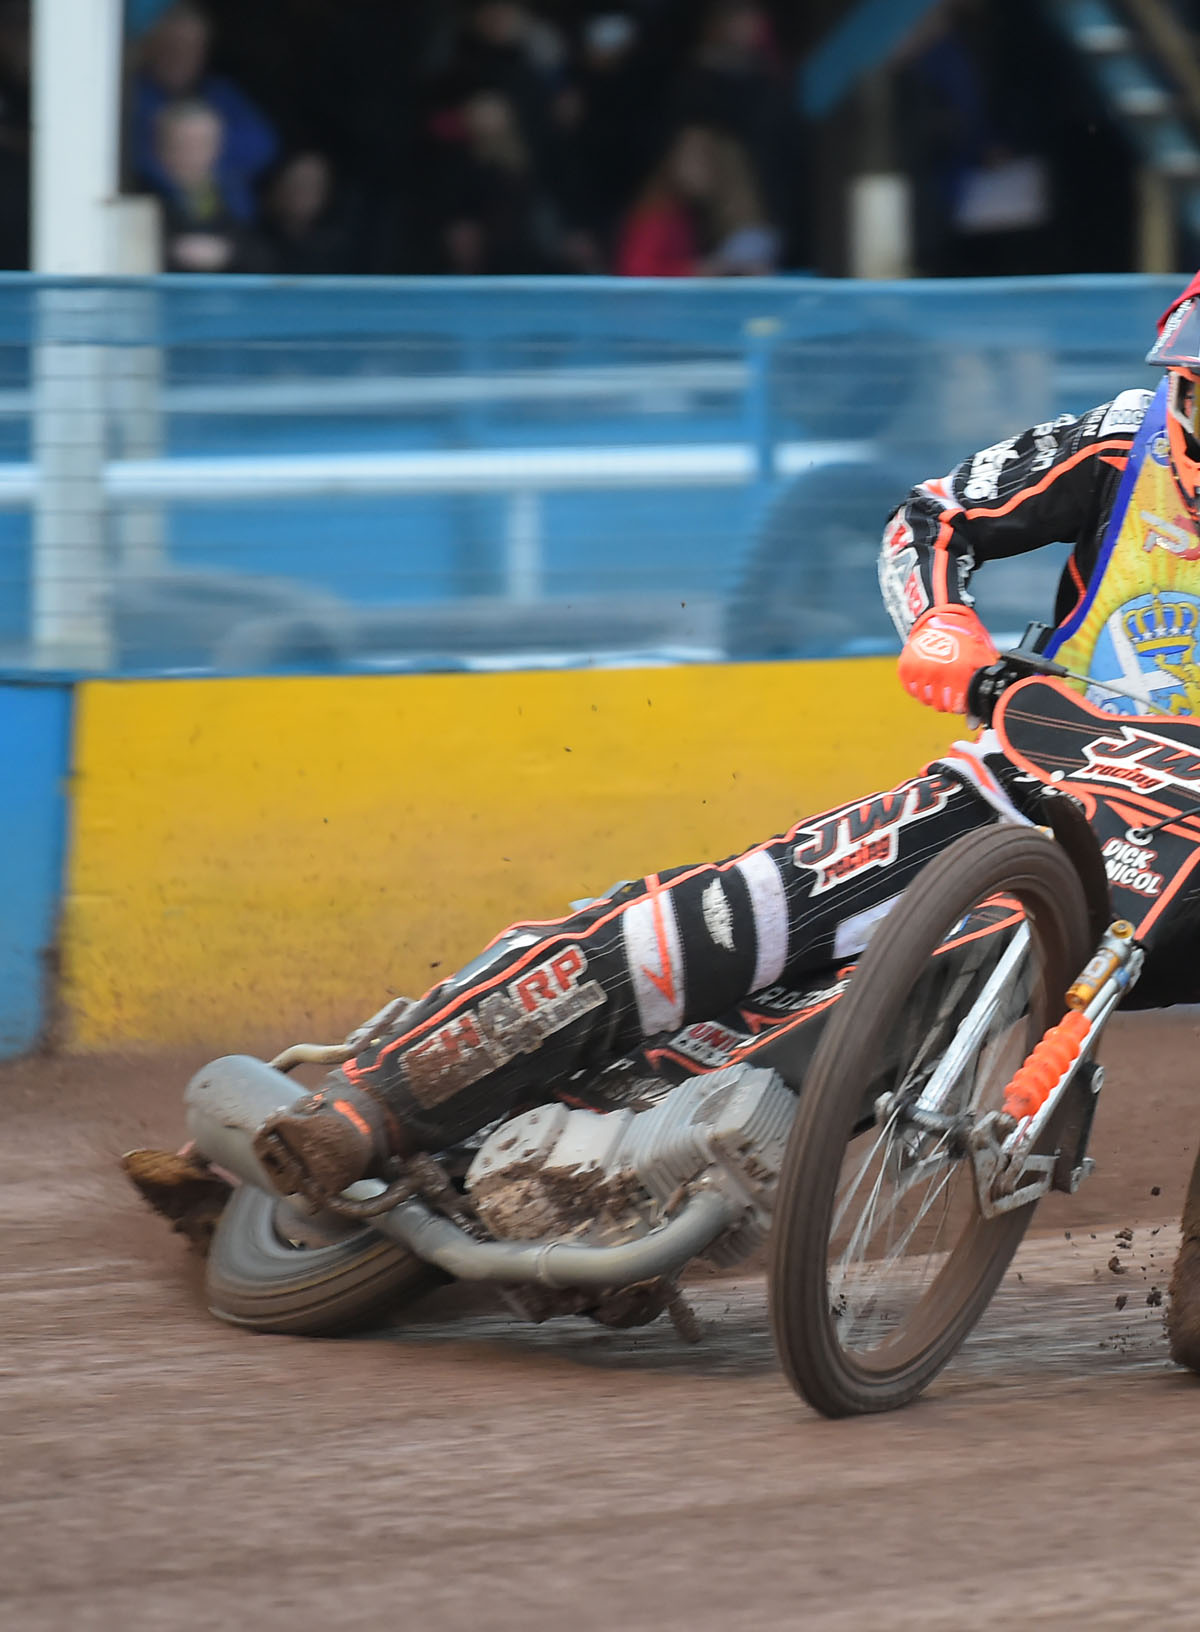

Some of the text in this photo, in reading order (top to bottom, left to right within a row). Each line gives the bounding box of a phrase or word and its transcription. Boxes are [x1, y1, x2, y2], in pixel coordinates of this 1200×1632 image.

[1082, 763, 1164, 789] racing
[1101, 839, 1155, 870] DICK
[1104, 860, 1162, 894] NICOL
